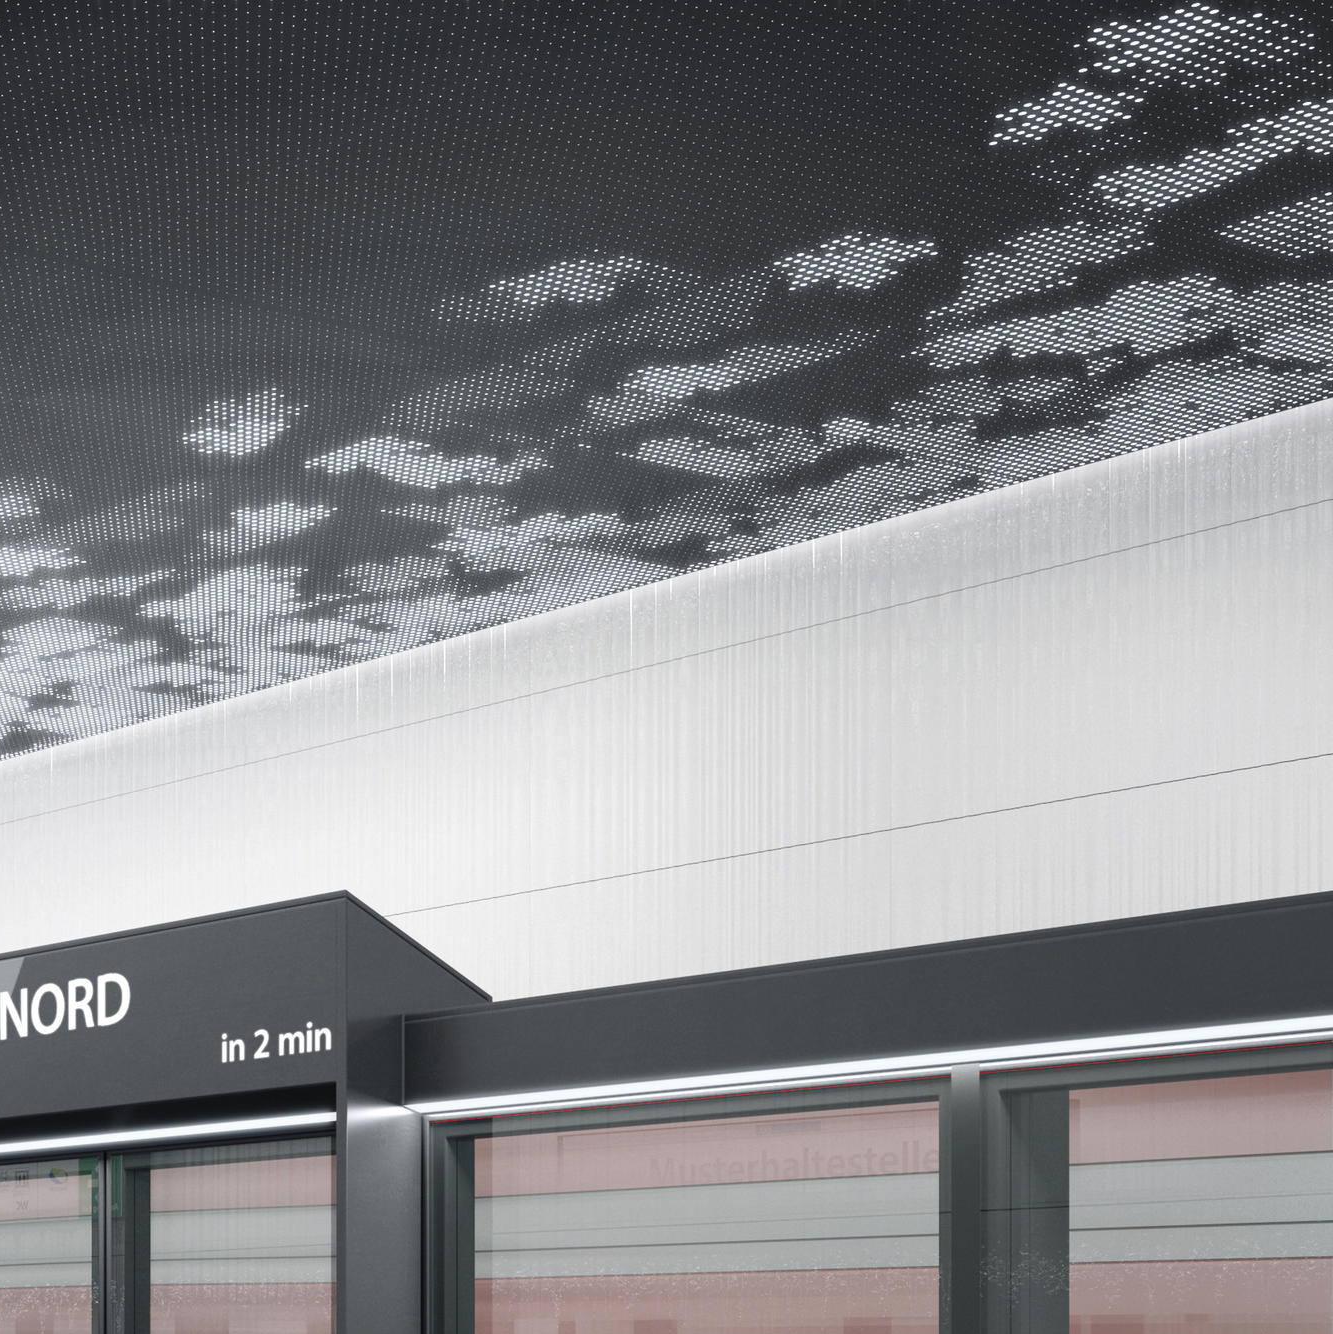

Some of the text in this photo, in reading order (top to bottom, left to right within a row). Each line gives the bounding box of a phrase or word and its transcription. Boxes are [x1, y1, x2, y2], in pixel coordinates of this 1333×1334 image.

[0, 974, 131, 1041] NORD
[221, 1022, 332, 1063] in 2 min
[649, 1140, 939, 1183] Musterhaltestelle
